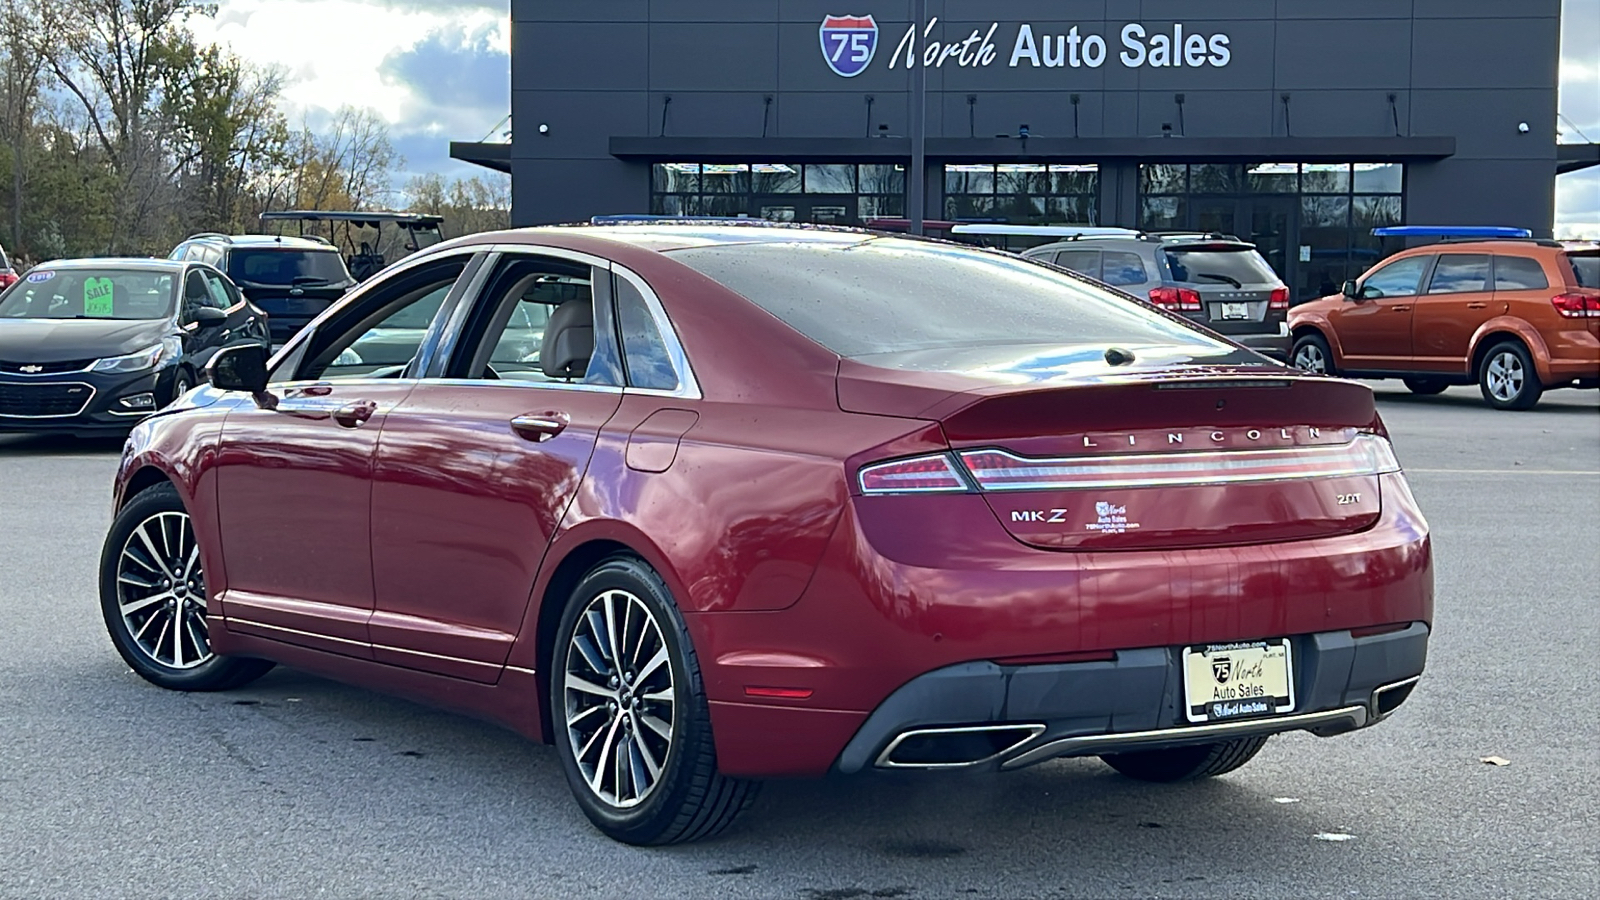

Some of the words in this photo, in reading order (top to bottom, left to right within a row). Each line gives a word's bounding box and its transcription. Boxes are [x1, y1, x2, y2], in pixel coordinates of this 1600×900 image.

[830, 33, 870, 64] 75
[888, 16, 999, 70] North
[1008, 23, 1107, 69] Auto
[1119, 22, 1232, 69] Sales
[86, 284, 111, 300] SALE
[1082, 427, 1321, 448] LINCOLN
[1214, 664, 1229, 679] 75
[1231, 659, 1264, 682] North
[1213, 686, 1236, 700] Auto
[1238, 683, 1265, 698] Sales
